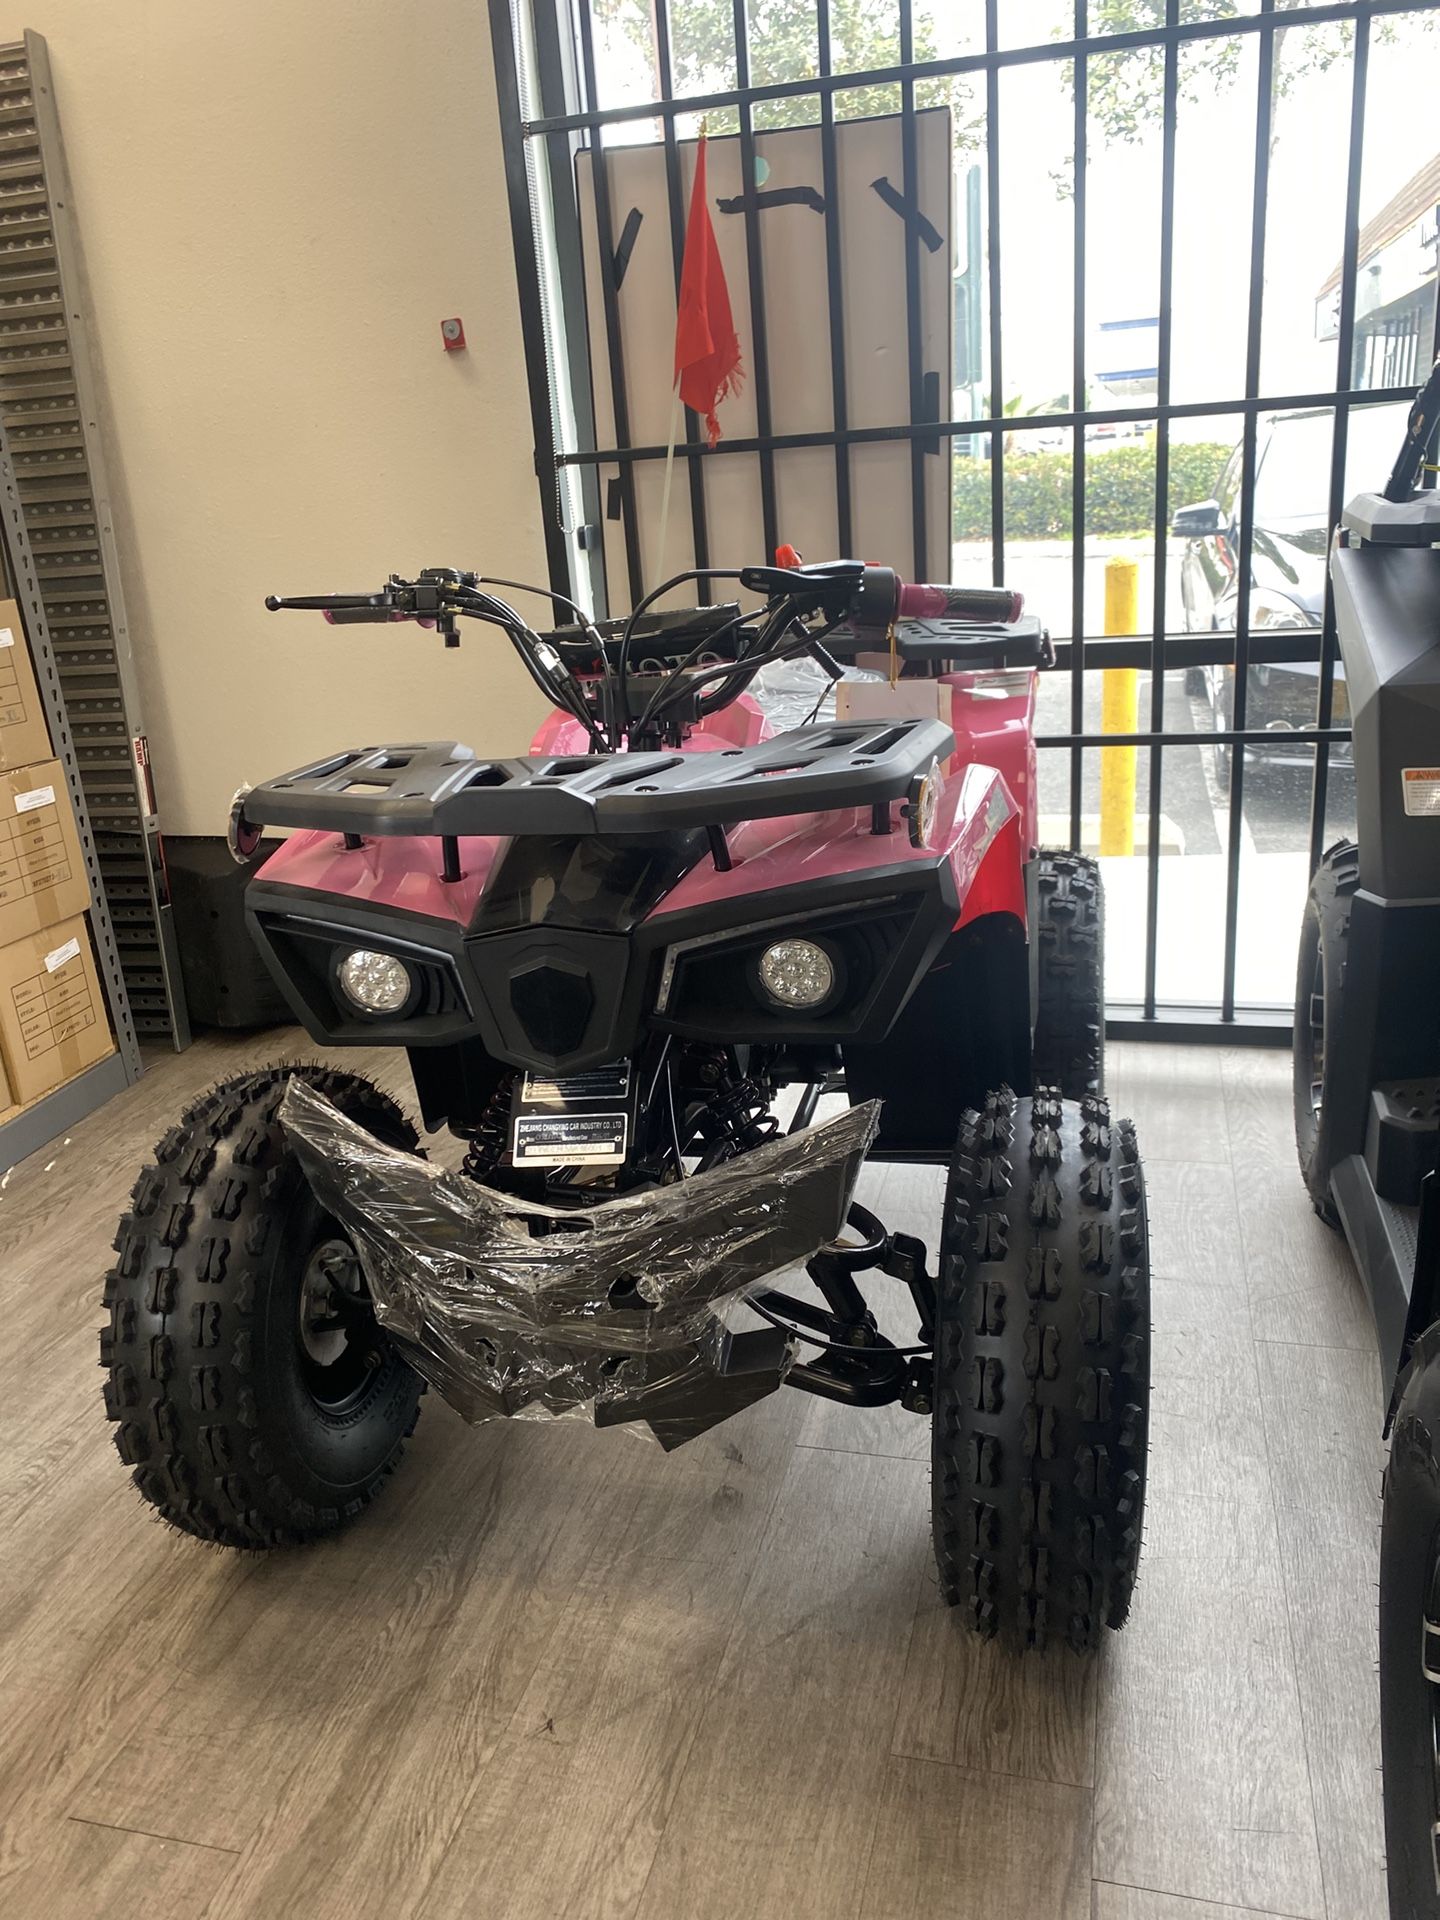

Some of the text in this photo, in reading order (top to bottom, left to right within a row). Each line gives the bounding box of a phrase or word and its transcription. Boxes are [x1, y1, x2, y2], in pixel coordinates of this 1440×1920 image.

[519, 1124, 542, 1133] ZHEJIANG
[569, 1122, 580, 1131] CAR
[580, 1122, 602, 1131] INDUSTRY
